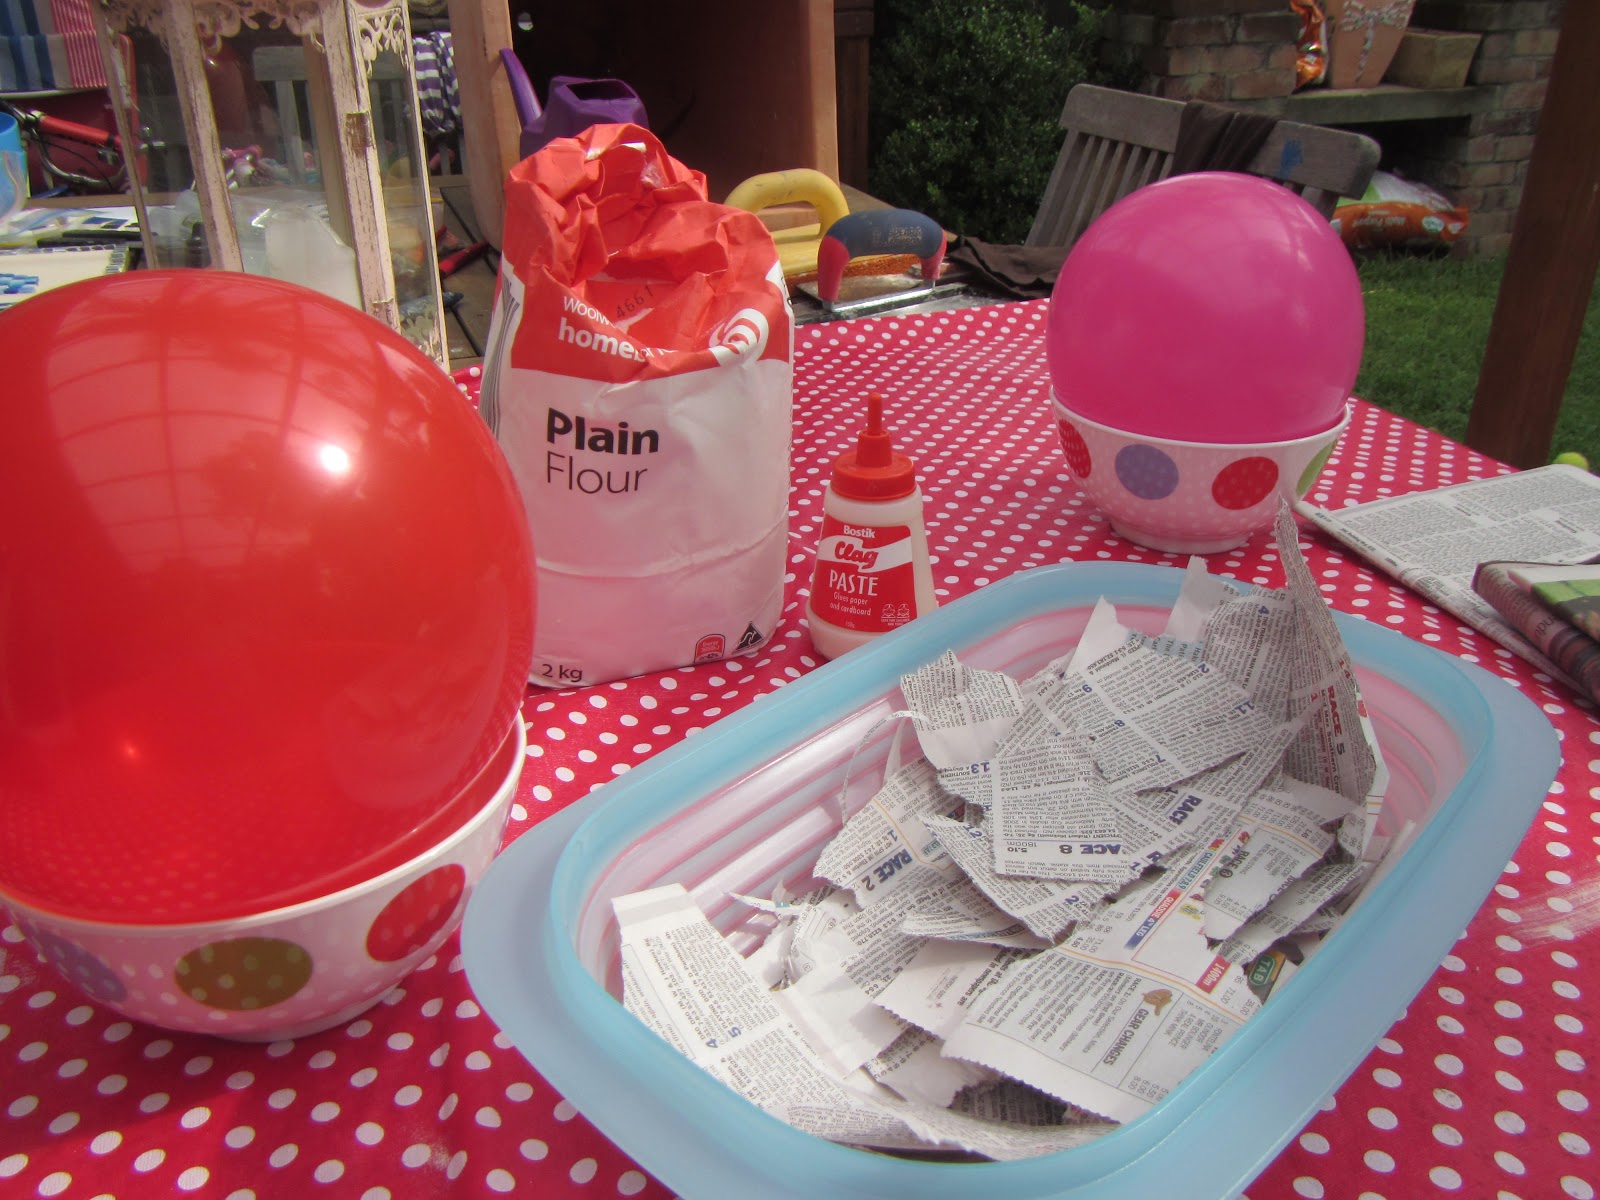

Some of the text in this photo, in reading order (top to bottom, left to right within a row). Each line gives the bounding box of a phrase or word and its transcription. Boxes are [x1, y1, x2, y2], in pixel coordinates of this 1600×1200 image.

[616, 285, 654, 319] 4661
[546, 407, 659, 455] Plain
[547, 450, 648, 495] Flour
[843, 524, 876, 538] Bostik
[835, 541, 879, 570] Clag
[829, 569, 879, 596] PASTE
[834, 592, 868, 605] Glues paper
[830, 602, 872, 616] and cardboard
[1257, 605, 1269, 614] 4
[542, 664, 583, 683] 2 kg
[1197, 662, 1209, 675] 2
[1081, 684, 1092, 694] 9
[1234, 699, 1254, 716] 11
[1113, 719, 1125, 729] 8
[1327, 686, 1345, 755] RACE 5
[1155, 754, 1166, 763] 7
[1327, 731, 1340, 772] Southern
[940, 761, 989, 778] 13 SOUTHERN
[1164, 784, 1178, 799] 1
[886, 829, 897, 841] 1
[884, 840, 892, 849] HOT
[1006, 839, 1036, 847] 1800m
[1059, 844, 1072, 854] 8
[1080, 841, 1120, 854] ACE
[873, 846, 884, 856] SPIN
[1226, 847, 1249, 868] RACE
[861, 850, 911, 891] RACE 2
[1187, 852, 1212, 878] CAULFIELD
[1151, 896, 1173, 918] QUADDIE
[1135, 925, 1149, 936] LEG
[1203, 963, 1224, 985] 1400m
[1250, 961, 1272, 982] TAB
[965, 968, 995, 995] newspapers
[1127, 977, 1141, 991] RACE
[957, 996, 967, 1005] are
[1239, 998, 1255, 1015] 35.00
[684, 1011, 695, 1024] DAO
[708, 1004, 728, 1028] PLAYING
[1075, 1013, 1094, 1031] Thomas
[694, 1026, 705, 1039] DAO
[727, 1026, 741, 1037] 5
[1103, 1008, 1148, 1064] GEAR CHANGES
[705, 1038, 718, 1048] 4
